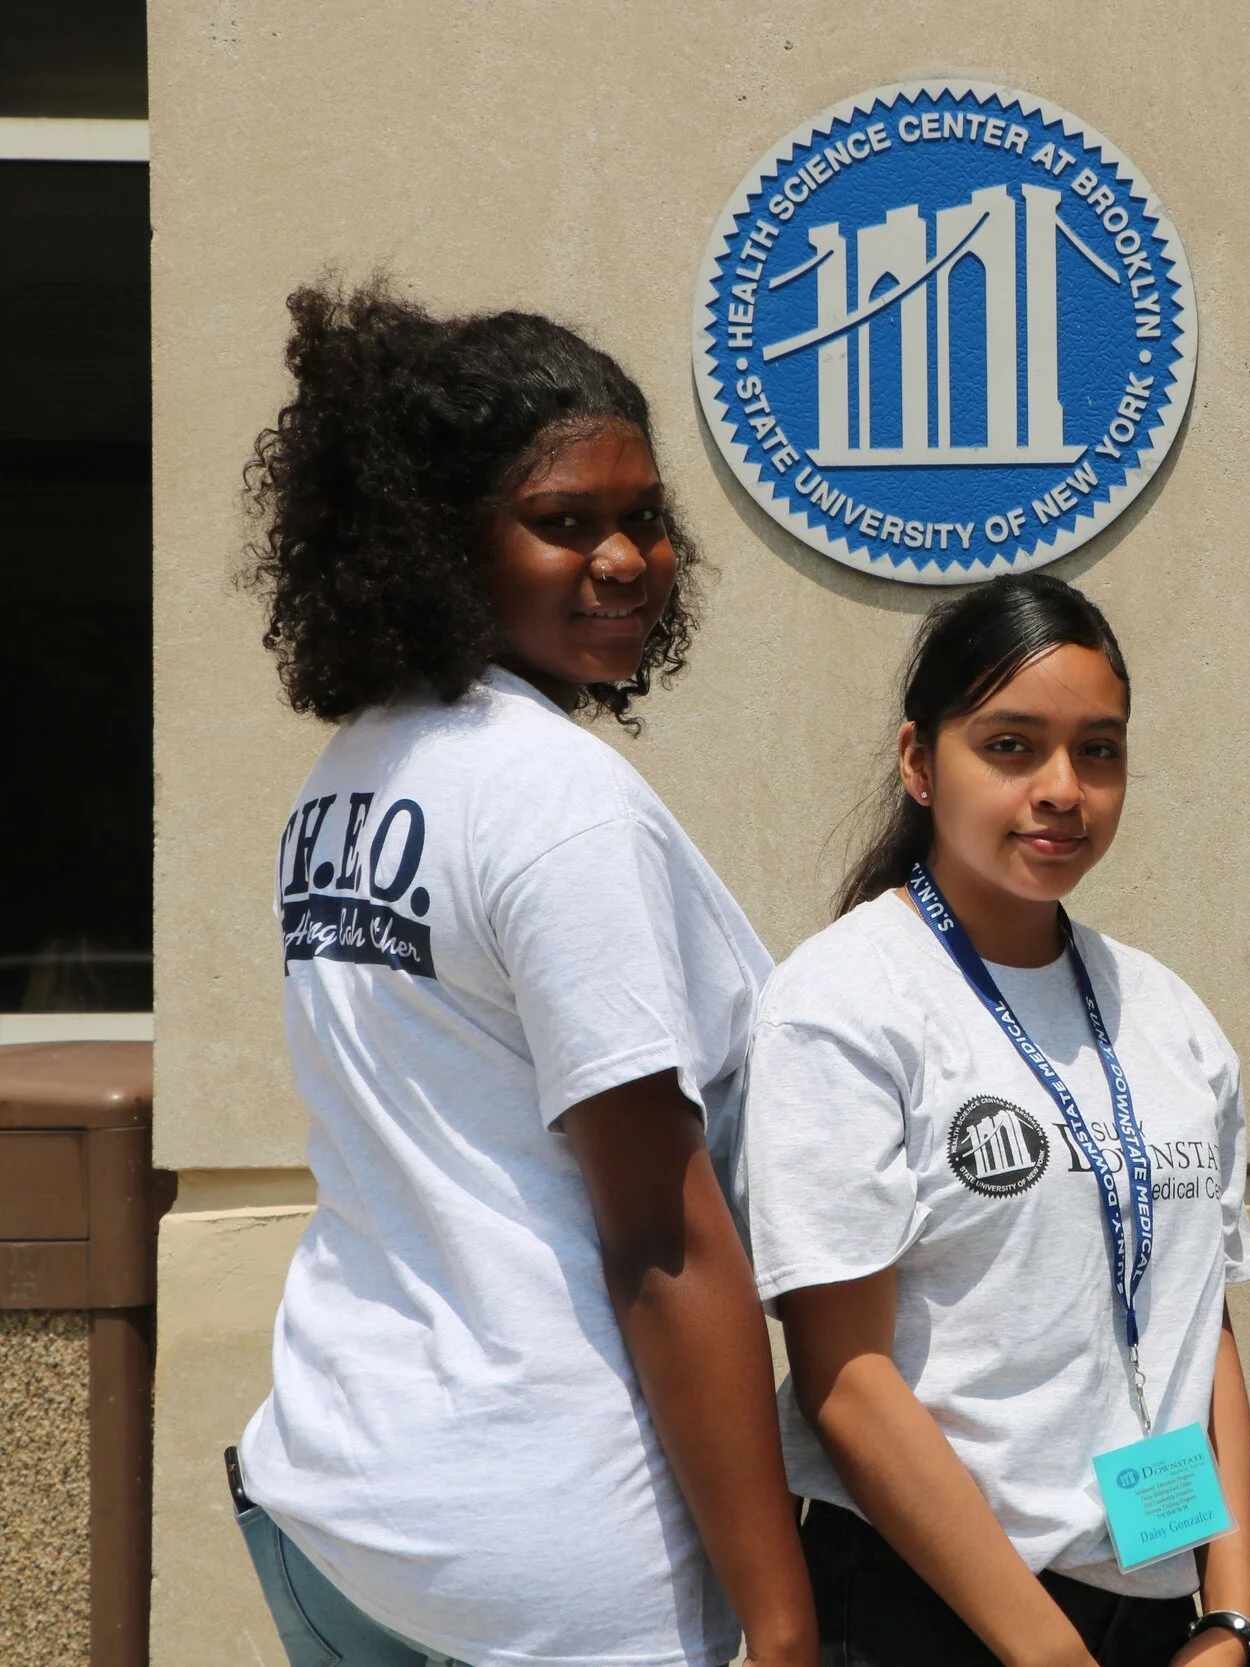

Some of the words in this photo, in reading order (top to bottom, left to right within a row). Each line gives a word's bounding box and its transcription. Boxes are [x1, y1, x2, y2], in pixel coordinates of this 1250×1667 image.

[728, 218, 779, 348] HEALTH
[768, 122, 891, 221] SCIENCE
[898, 112, 1031, 155] CENTER
[1032, 142, 1076, 177] AT
[1071, 167, 1161, 338] BROOKLYN
[736, 376, 800, 474] STATE
[794, 467, 975, 550] UNIVERSITY
[984, 510, 1027, 544] OF
[1033, 463, 1098, 525] NEW
[1095, 371, 1155, 459] YORK
[995, 1001, 1055, 1077] MEDICAL
[957, 1100, 980, 1126] SCIENCE
[980, 1097, 1005, 1106] CENTER
[1005, 1102, 1014, 1110] AT
[1091, 1120, 1146, 1142] SUY
[960, 1165, 977, 1183] STATE
[976, 1180, 1017, 1192] UNIVERSITY
[1017, 1178, 1027, 1188] OF
[1026, 1167, 1039, 1181] NEW
[1035, 1149, 1045, 1168] YORK
[1052, 1080, 1118, 1207] DOWNSTATE
[1111, 1064, 1147, 1181] DOWNSTATE
[1132, 1186, 1152, 1281] MEDICAL
[1152, 1177, 1200, 1200] edical
[1139, 1528, 1167, 1544] Daisy
[1169, 1509, 1215, 1533] Gonzalez
